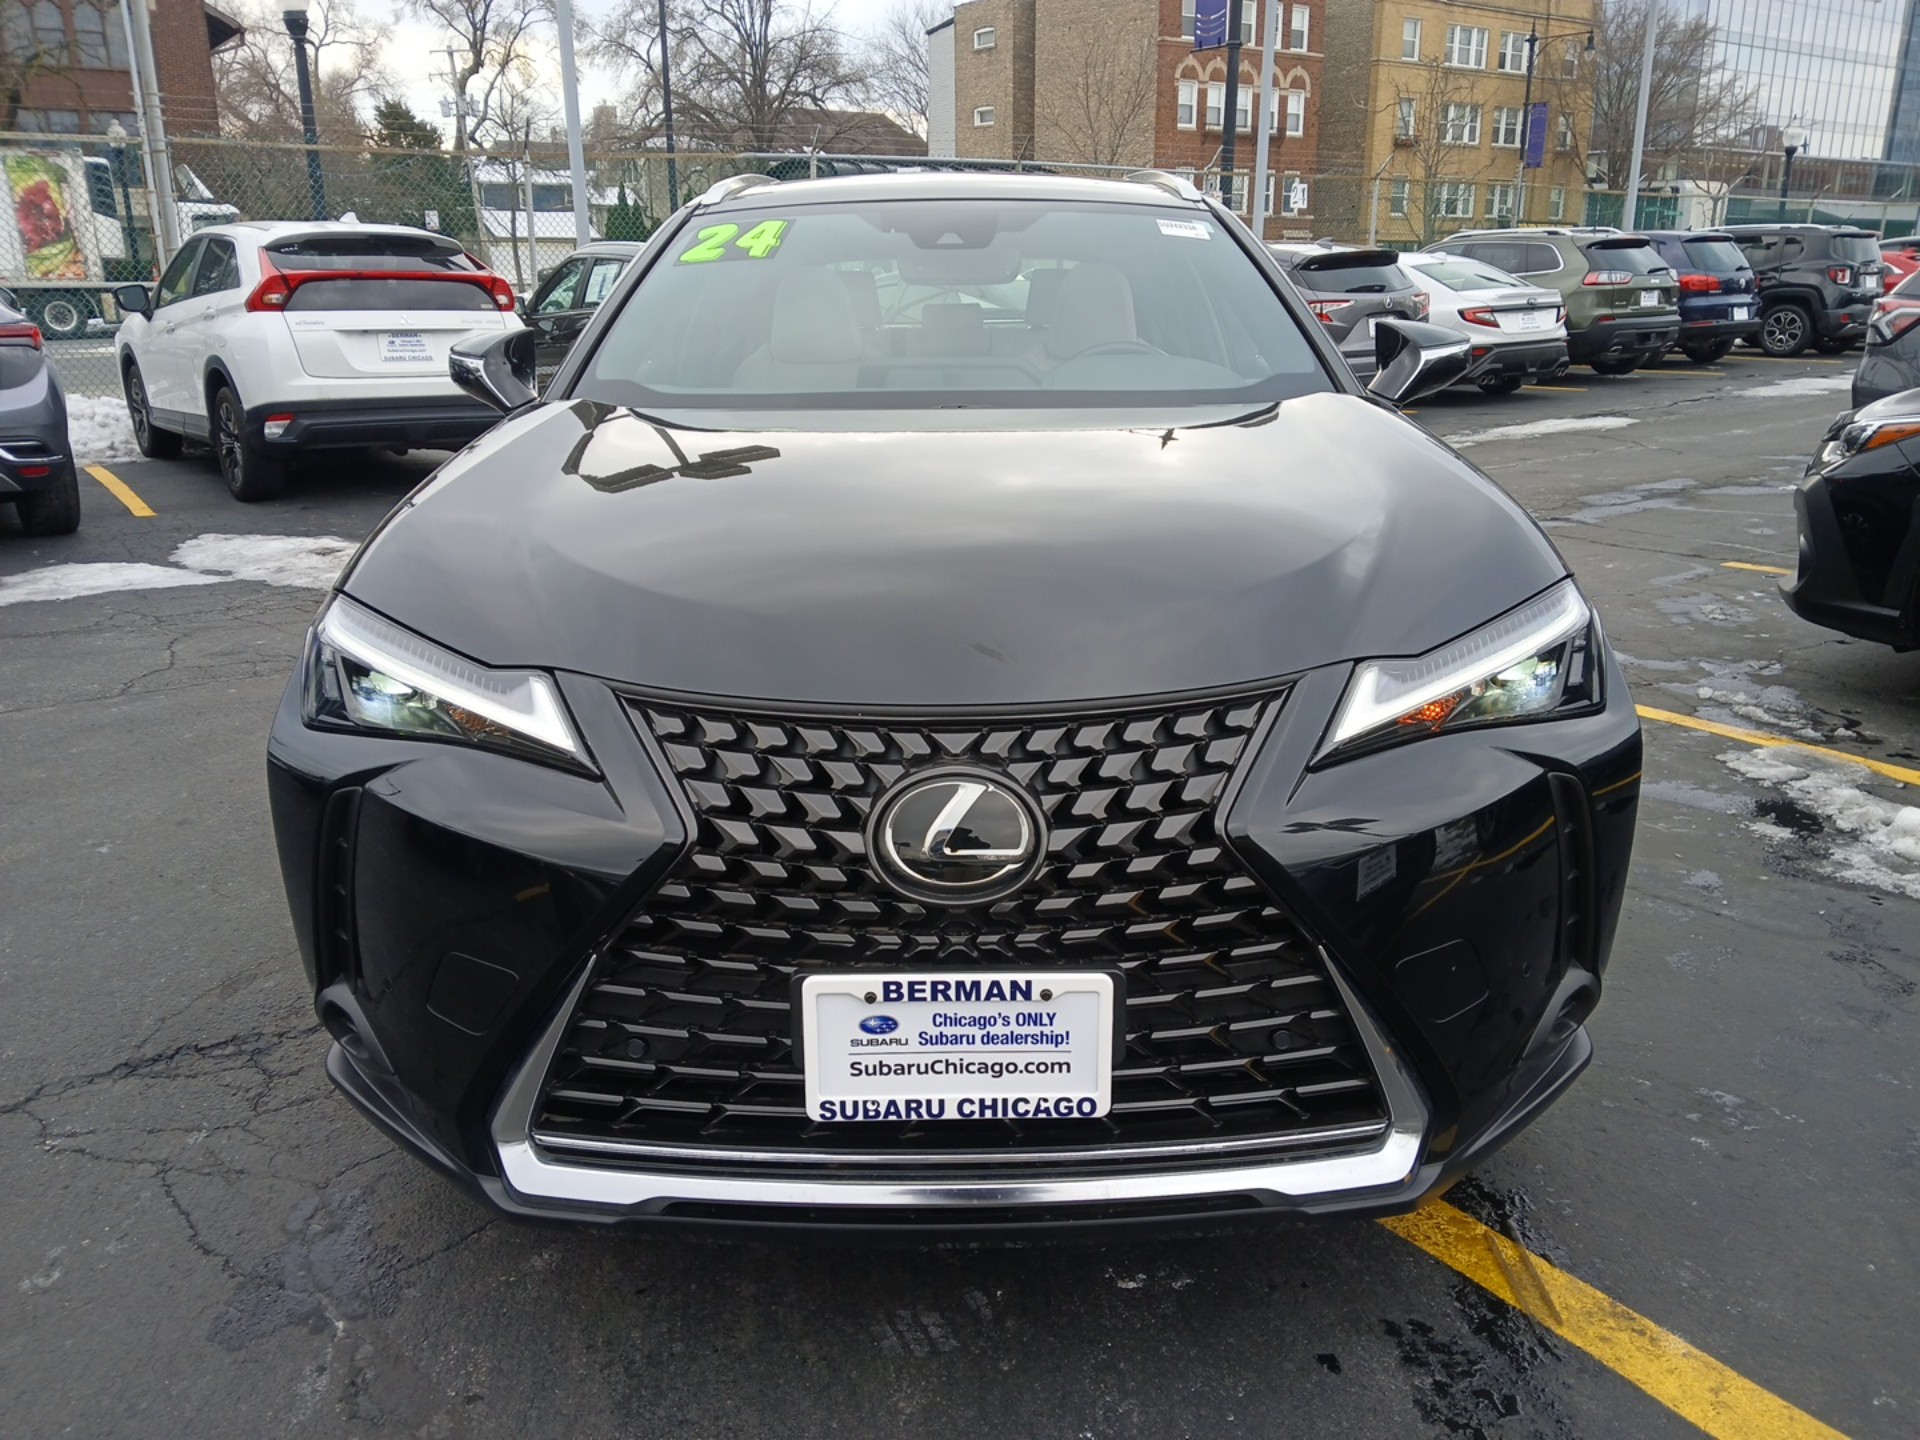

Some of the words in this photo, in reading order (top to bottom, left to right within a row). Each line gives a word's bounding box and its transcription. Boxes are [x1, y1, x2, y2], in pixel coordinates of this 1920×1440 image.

[679, 219, 788, 264] 24
[882, 980, 1033, 1002] BERMAN
[932, 1012, 1011, 1031] Chicago's
[1015, 1012, 1057, 1027] ONLY
[850, 1038, 908, 1047] SUBARU
[918, 1031, 976, 1047] Subaru
[980, 1031, 1070, 1048] dealership!
[850, 1059, 1071, 1079] SubaruChicago.com
[819, 1099, 946, 1121] SUBARU
[956, 1097, 1098, 1119] CHICAGO
